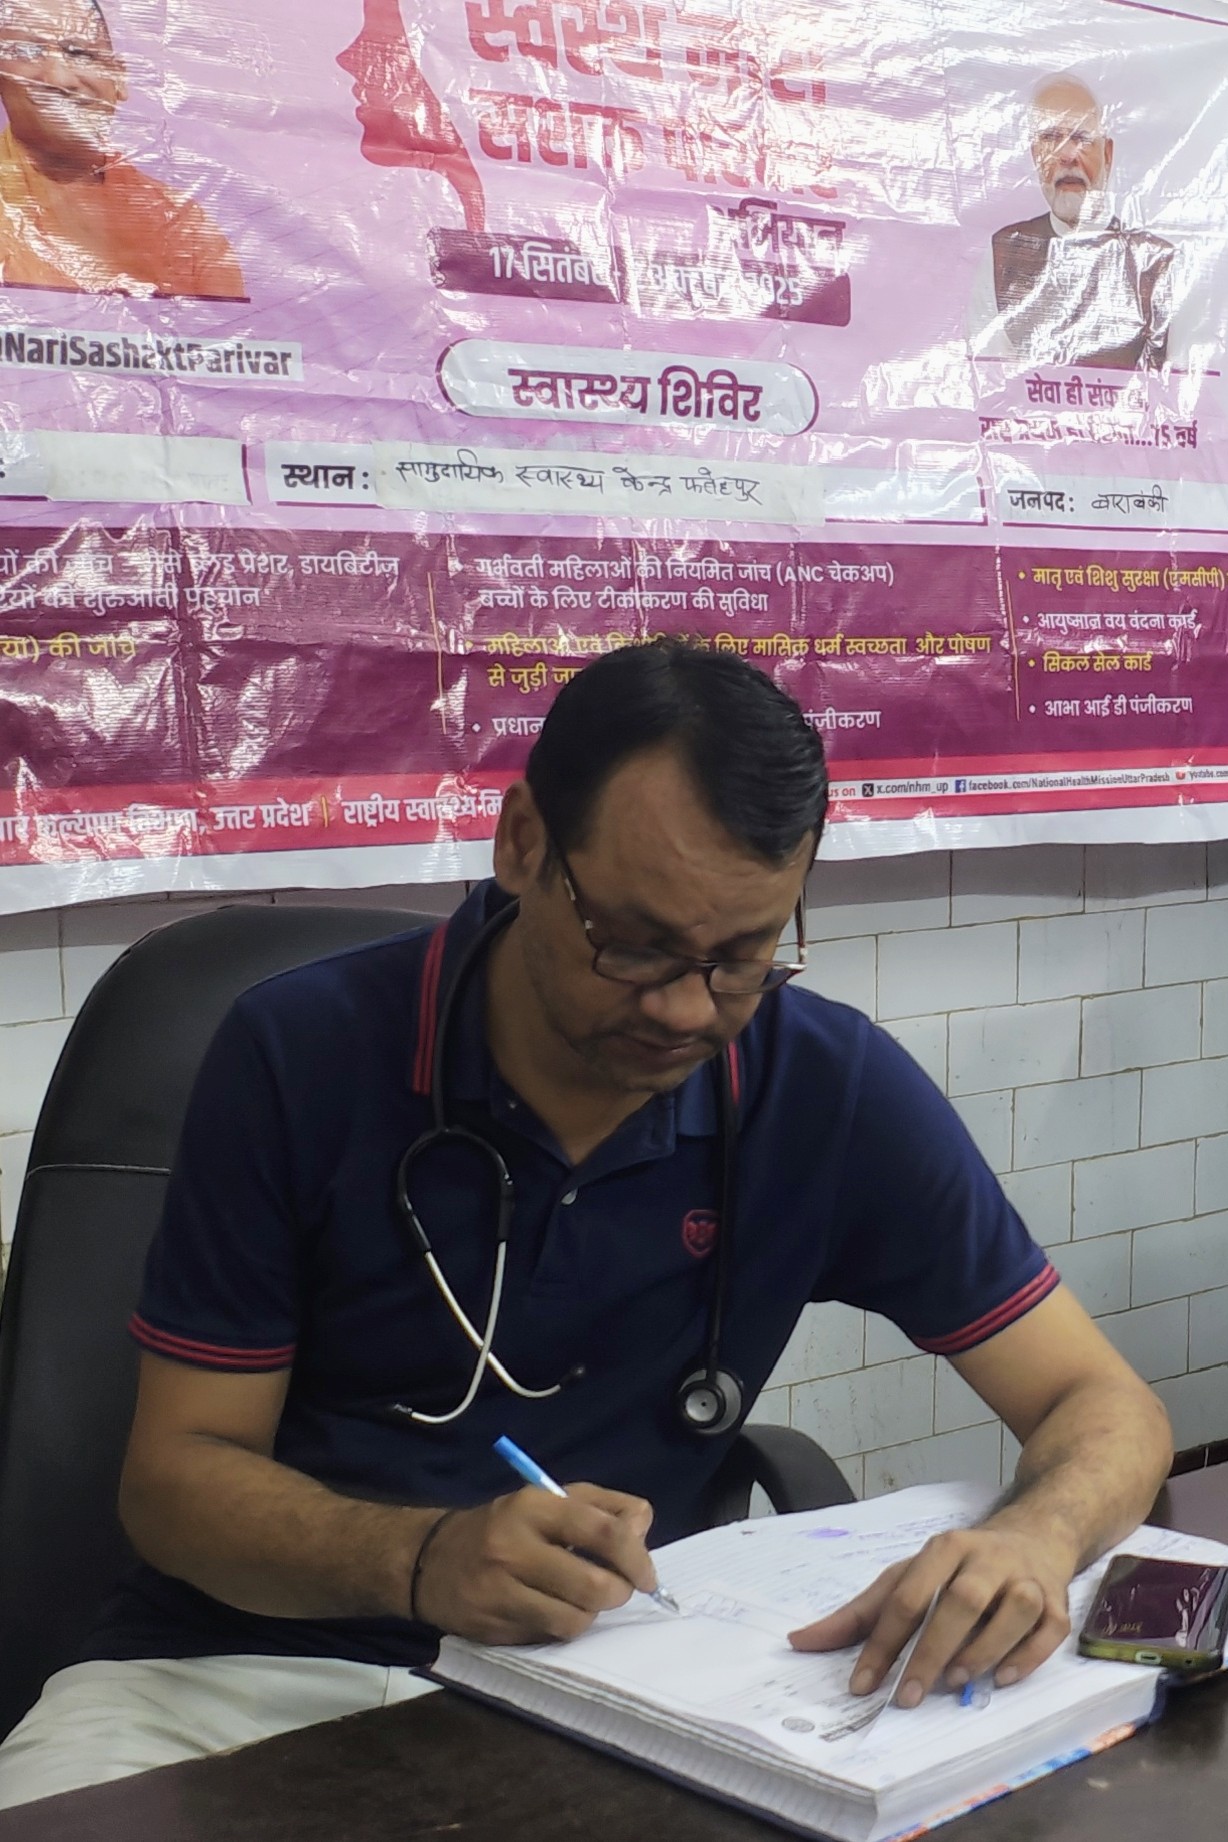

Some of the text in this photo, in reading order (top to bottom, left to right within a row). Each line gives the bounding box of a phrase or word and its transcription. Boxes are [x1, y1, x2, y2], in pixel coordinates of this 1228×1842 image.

[489, 245, 513, 280] 17
[0, 332, 292, 377] NariSashaktParivar
[507, 364, 764, 422] स्वास्थ्य शिविर
[1026, 373, 1062, 405] सेवा
[1063, 375, 1083, 406] ही
[23, 547, 60, 574] की
[474, 553, 895, 587] गर्भवती महिलाओं की नियमित जांच (ANC चेकअप)
[1031, 567, 1062, 591] मातृ
[1064, 566, 1085, 587] एवं
[1085, 564, 1119, 592] शिशु
[1120, 568, 1160, 592] सुरक्षा
[1162, 567, 1226, 592] (एमसीपी)
[477, 585, 769, 617] बच्चों के लिए टीकाकरण की सुविधा
[1103, 612, 1127, 631] वय
[1128, 609, 1167, 631] वंदना
[1168, 609, 1199, 632] कार्ड
[49, 631, 81, 658] की
[813, 633, 845, 656] धर्म
[845, 638, 907, 656] स्वच्छता
[915, 632, 945, 655] और
[946, 632, 992, 655] पोषण
[1043, 650, 1153, 673] सिकल सेल कार्ड
[487, 662, 506, 688] से
[510, 662, 549, 694] जुड़ी
[1044, 692, 1194, 718] आभा आई डी पंजीकरण
[842, 786, 856, 797] on
[876, 780, 949, 796] x.com/nhm_up
[211, 805, 257, 831] उत्तर
[260, 797, 311, 829] प्रदेश
[341, 792, 401, 829] राष्ट्रीय
